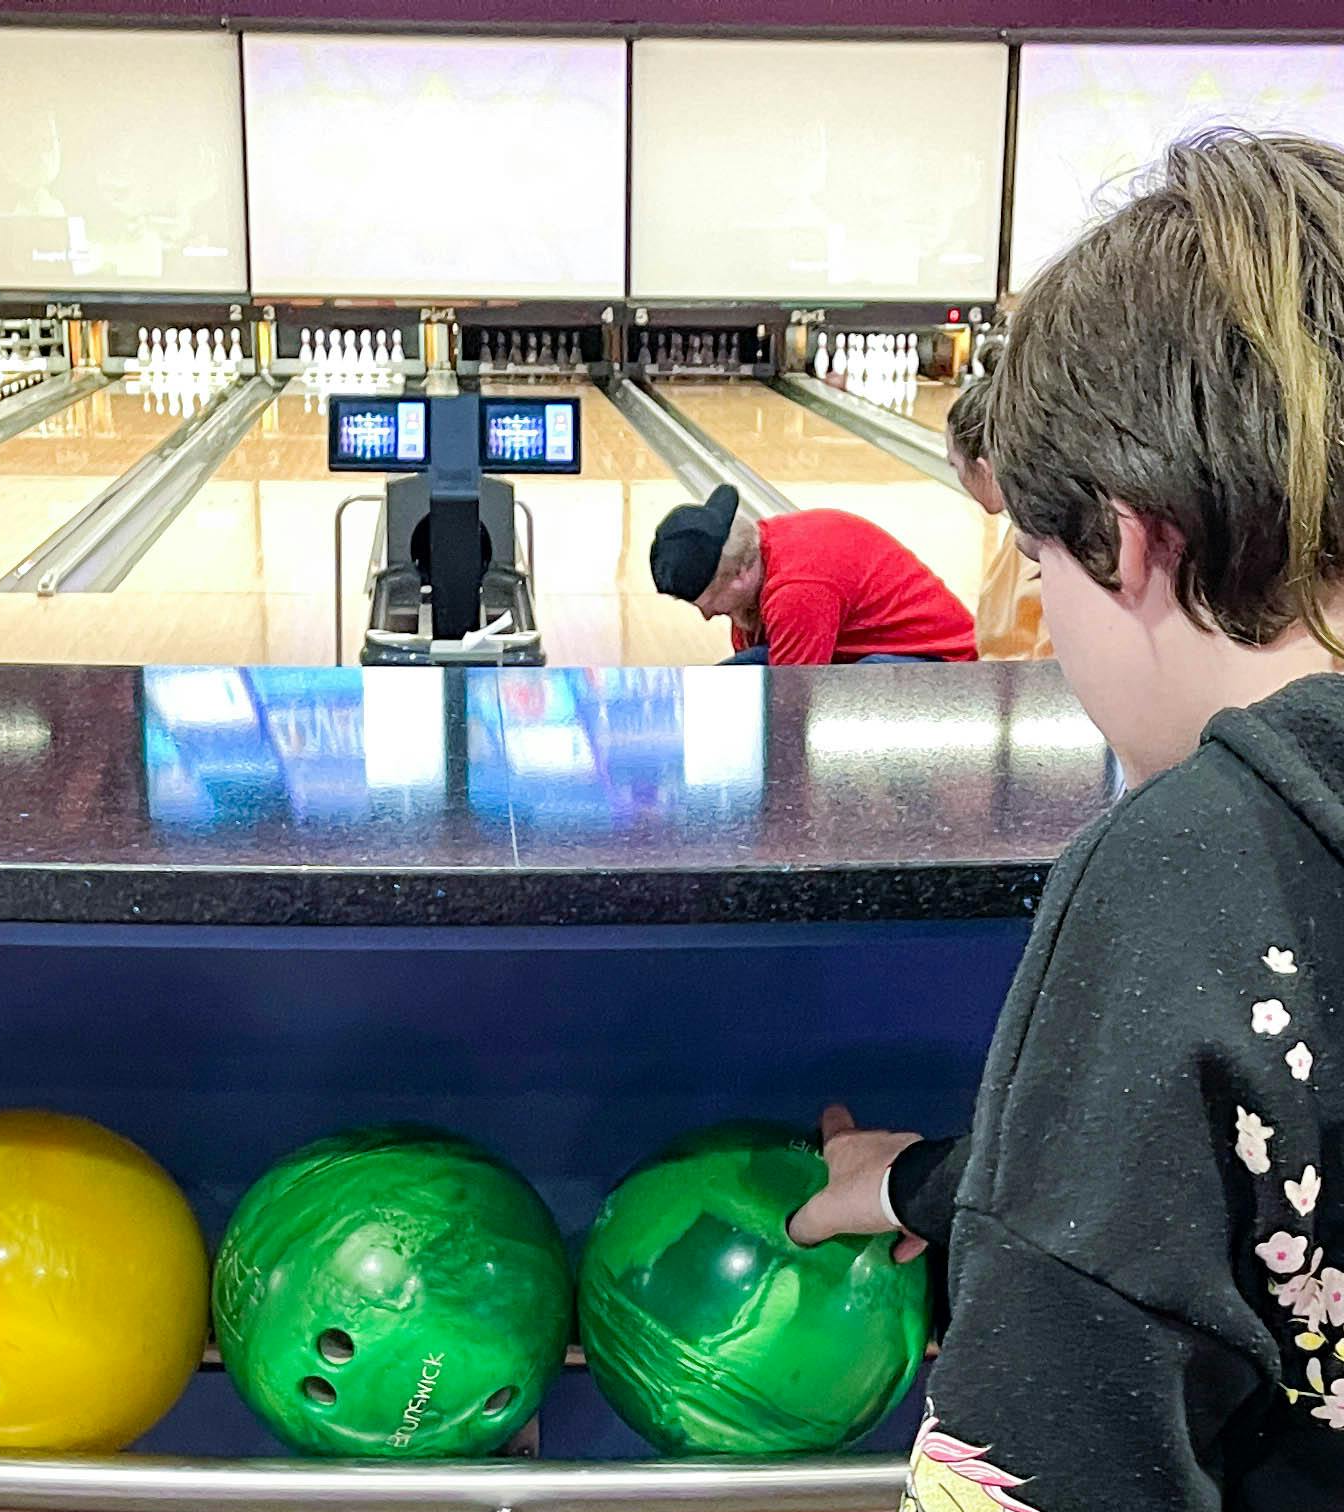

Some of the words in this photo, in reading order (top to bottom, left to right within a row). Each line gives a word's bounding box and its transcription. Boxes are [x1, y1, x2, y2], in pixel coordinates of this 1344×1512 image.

[229, 304, 242, 320] 2
[262, 304, 275, 320] 3
[601, 306, 614, 323] 4
